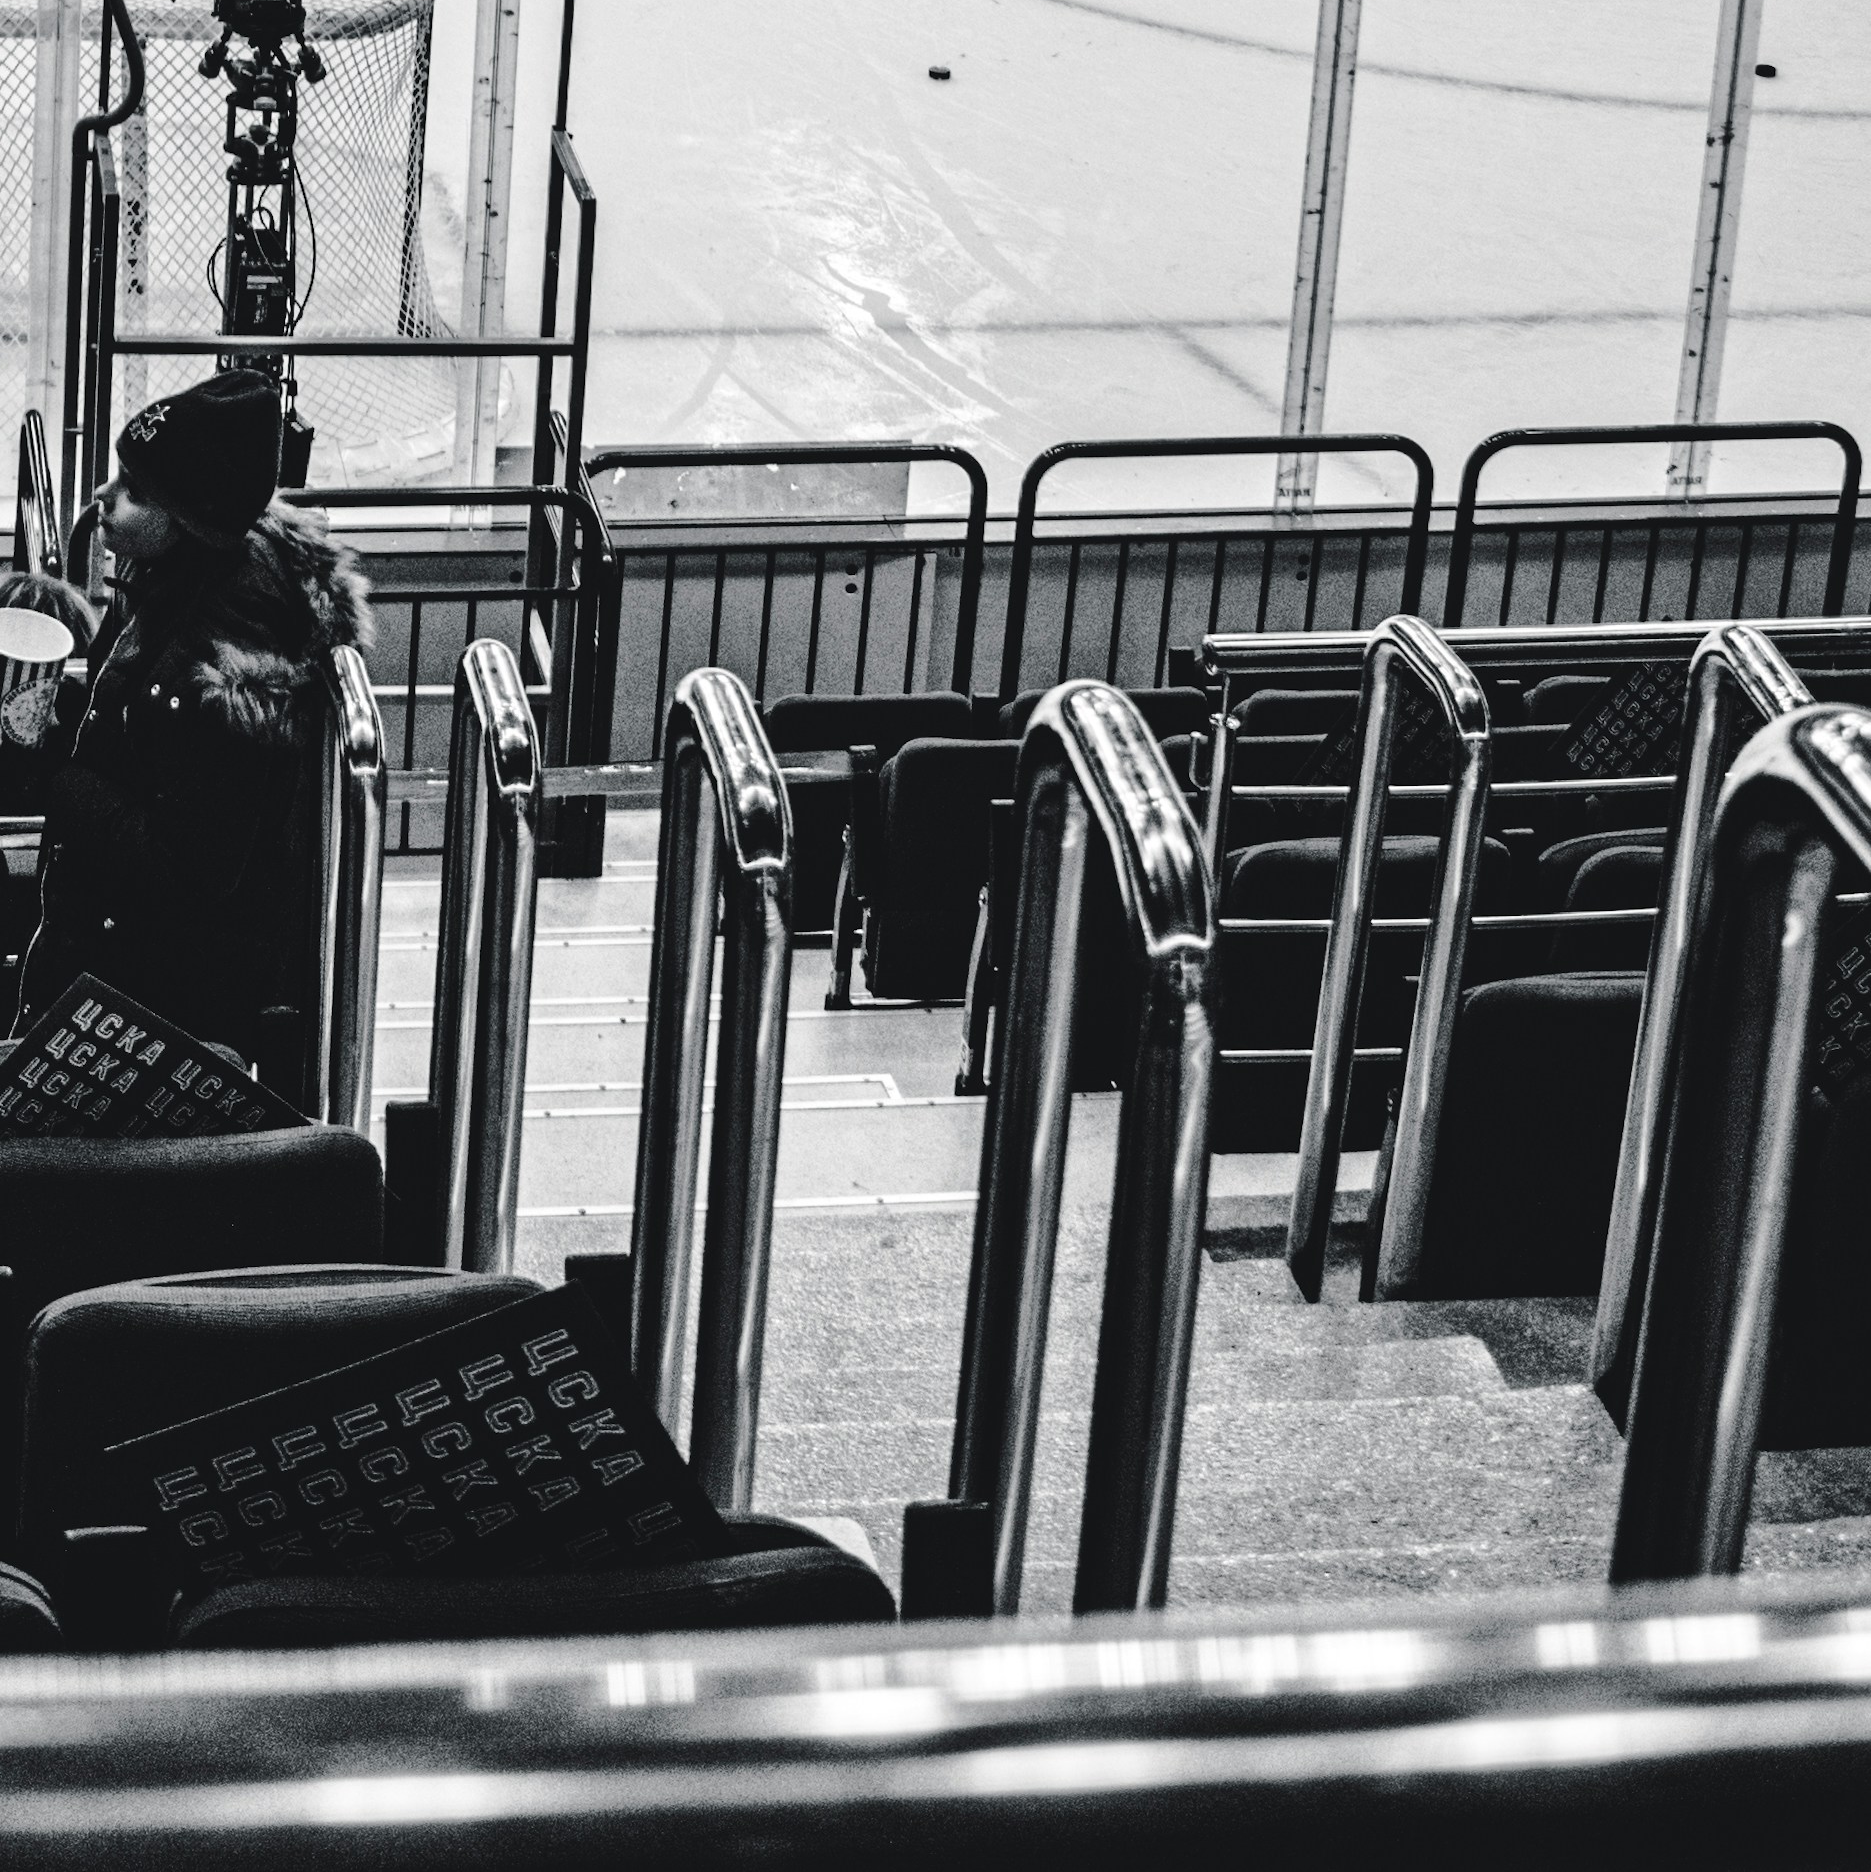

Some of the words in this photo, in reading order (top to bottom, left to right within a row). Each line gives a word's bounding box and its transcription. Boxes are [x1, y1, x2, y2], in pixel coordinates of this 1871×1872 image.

[18, 1057, 112, 1121] ЦСКА
[45, 1028, 139, 1094] ЦСКА
[72, 998, 166, 1067] ЦСКА
[171, 1058, 266, 1131] ЦСКА
[395, 1378, 520, 1538] ЦСКА
[458, 1354, 581, 1512] ЦСКА
[522, 1328, 645, 1488] ЦСКА
[333, 1403, 455, 1562] ЦСКА
